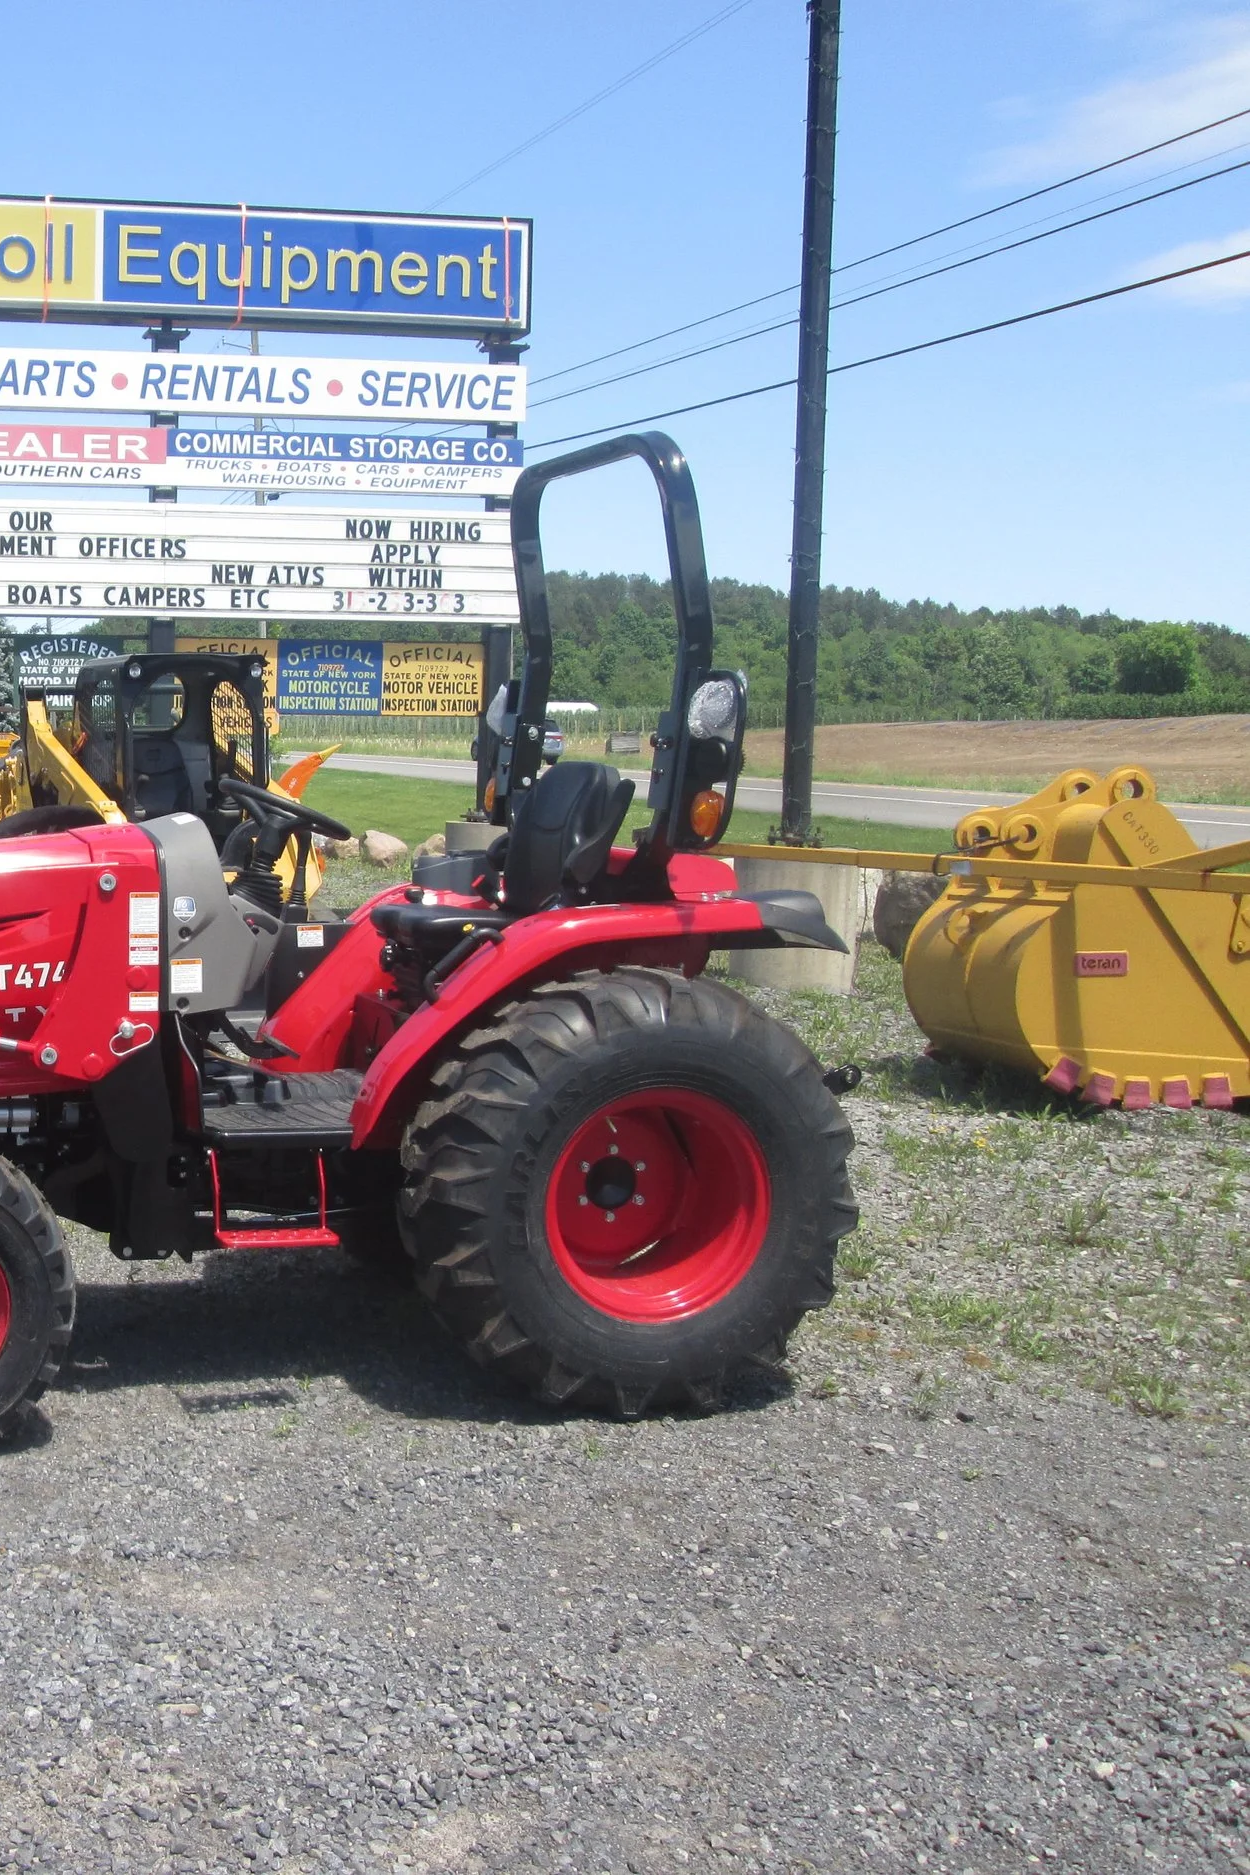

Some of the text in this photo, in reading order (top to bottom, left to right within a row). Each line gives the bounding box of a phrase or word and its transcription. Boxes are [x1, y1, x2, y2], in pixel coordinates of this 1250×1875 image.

[119, 224, 497, 304] Equipment
[140, 362, 312, 404] RENTALS
[358, 369, 516, 411] SERVICE
[174, 432, 513, 463] COMMERCIAL STORAGE CO.
[90, 466, 142, 480] CARS
[185, 459, 503, 478] TRUCKS BOATS CARS CAMPERS
[222, 473, 468, 490] WAREHOUSING EQUIPMENT
[9, 511, 53, 531] OUR
[345, 519, 481, 541] NOW HIRING
[79, 536, 187, 559] OFFICERS
[371, 544, 441, 565] APPLY
[211, 564, 325, 586] NEW ATVS
[368, 568, 443, 589] WITHIN
[8, 584, 82, 606] BOATS
[104, 586, 206, 608] CAMPERS
[230, 589, 270, 609] ETC
[53, 658, 84, 666] 7109727
[288, 645, 374, 667] OFFICIAL
[390, 647, 474, 668] OFFICIAL
[20, 666, 48, 674] STATE
[289, 680, 369, 694] MOTORCYCLE
[383, 681, 478, 694] MOTOR VEHICLE
[279, 696, 336, 710] INSPECTION
[339, 697, 378, 711] STATION
[381, 699, 478, 712] INSPECTION STATION
[1081, 956, 1121, 969] teran
